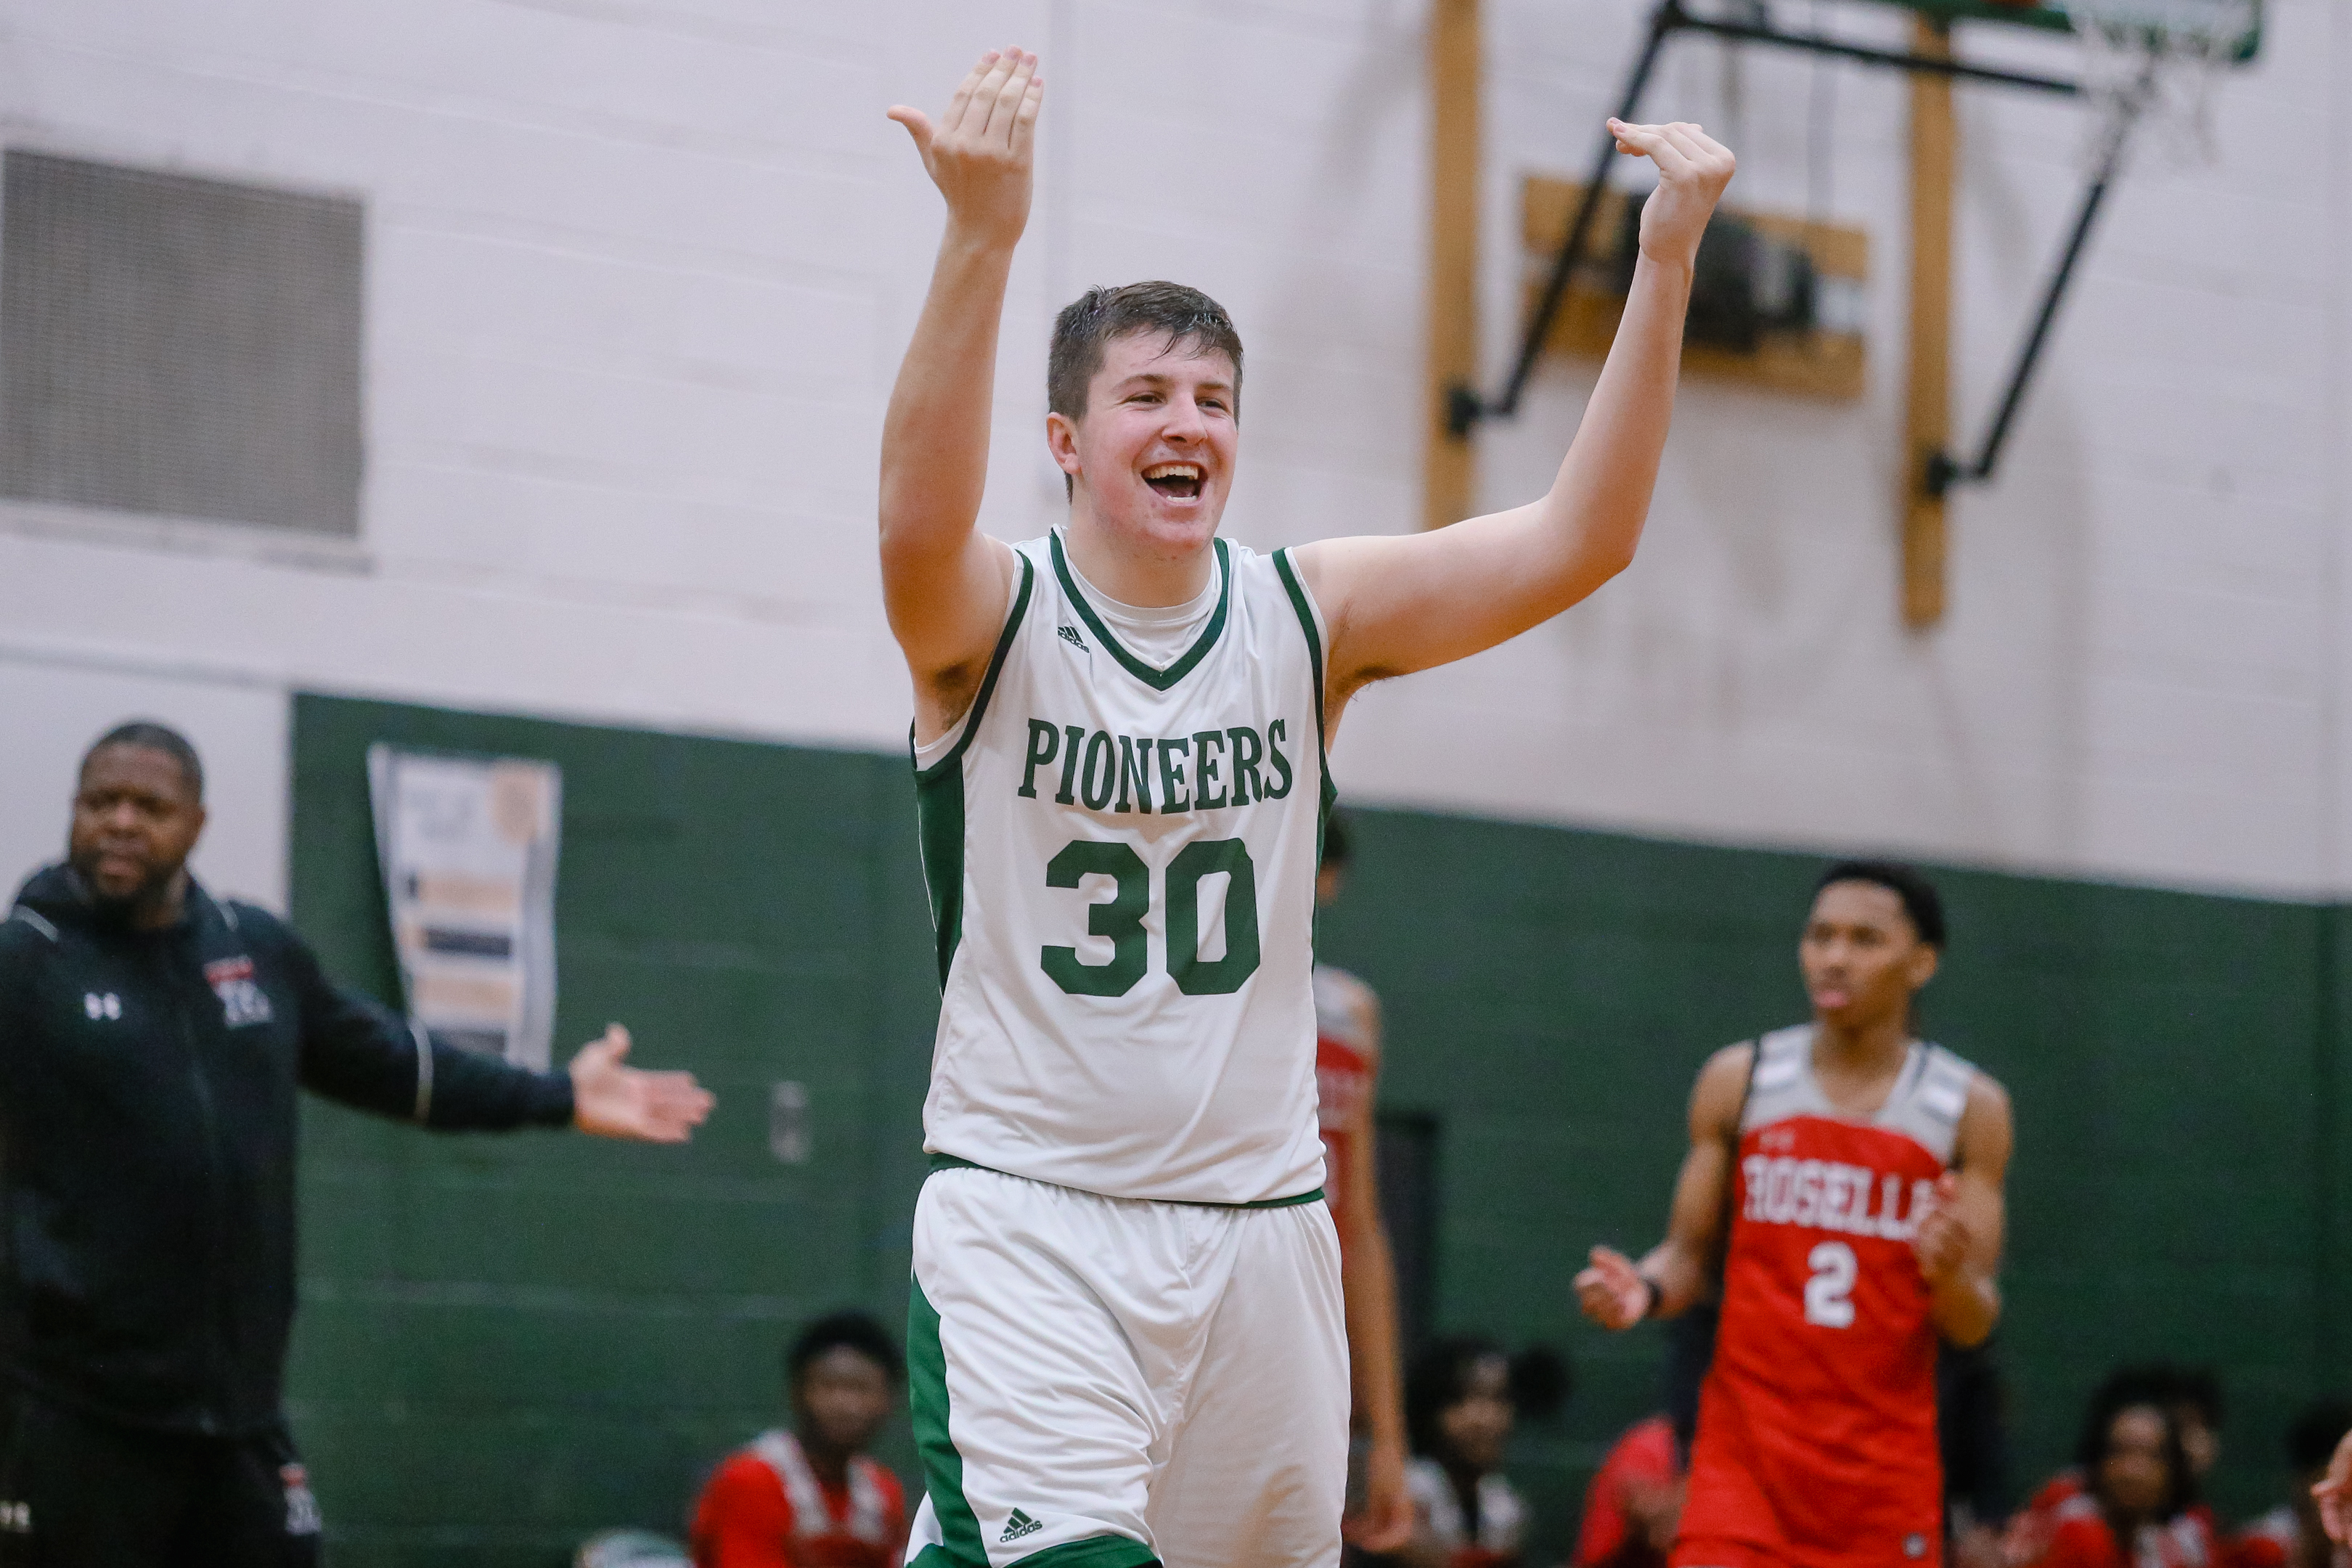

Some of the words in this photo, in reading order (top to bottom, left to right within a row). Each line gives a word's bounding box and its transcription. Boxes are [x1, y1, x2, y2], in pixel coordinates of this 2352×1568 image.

[1018, 718, 1292, 814] PIONEERS
[1041, 837, 1260, 997] 30
[1805, 1241, 1858, 1328] 2
[1000, 1520, 1042, 1543] adidas
